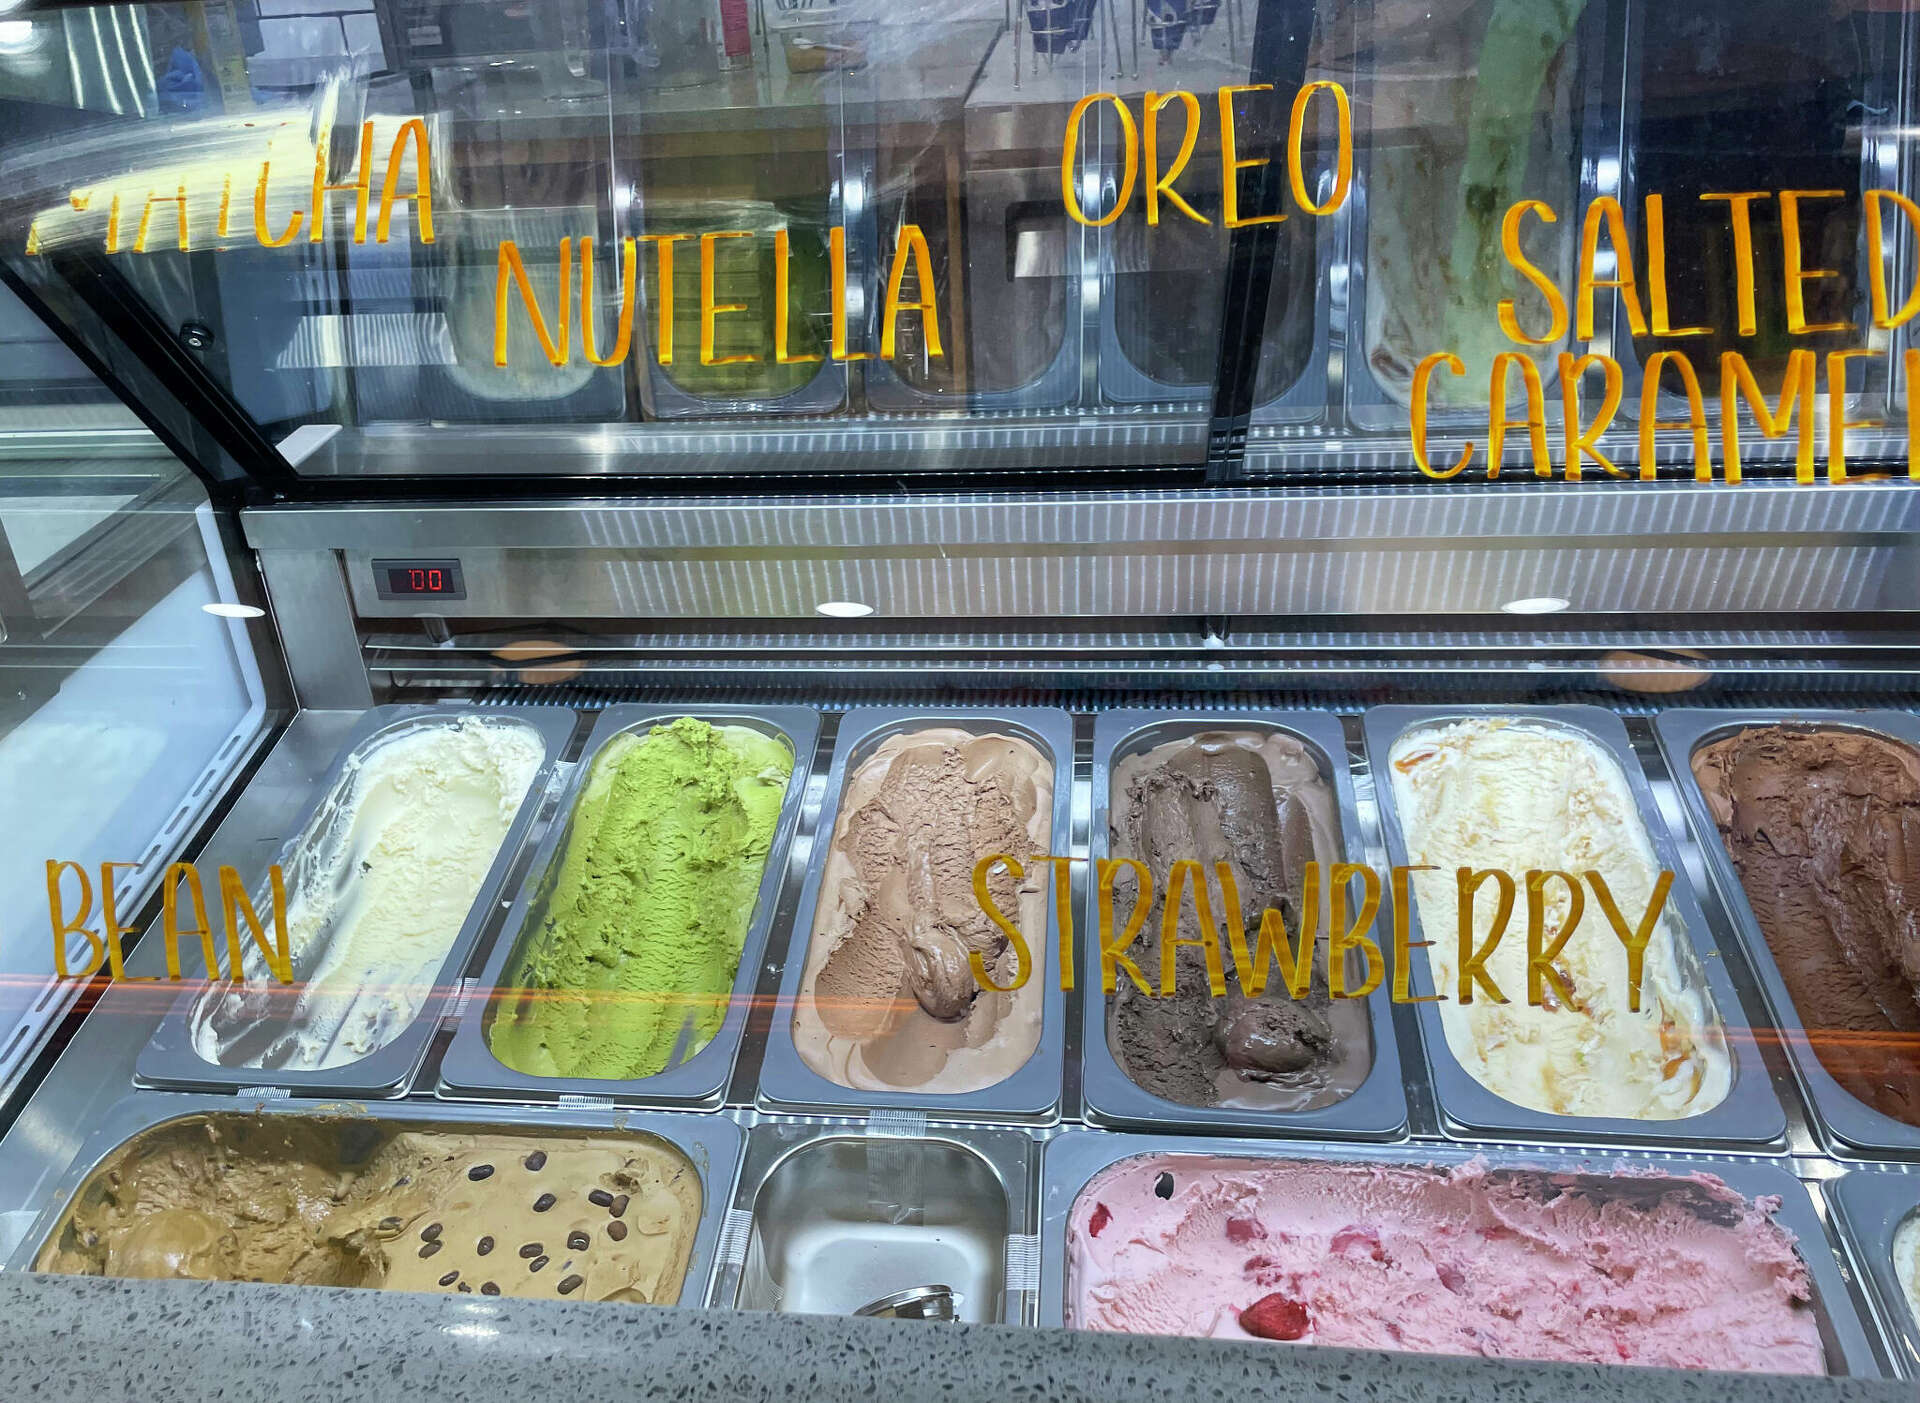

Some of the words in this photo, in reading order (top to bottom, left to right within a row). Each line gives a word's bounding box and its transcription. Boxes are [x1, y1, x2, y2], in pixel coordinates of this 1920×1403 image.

[1062, 80, 1353, 228] OREO
[494, 224, 943, 367] NUTELLA
[1498, 190, 1920, 345] SALTED
[46, 859, 293, 985] BEAN
[968, 854, 1675, 1013] STRAWBERRY
